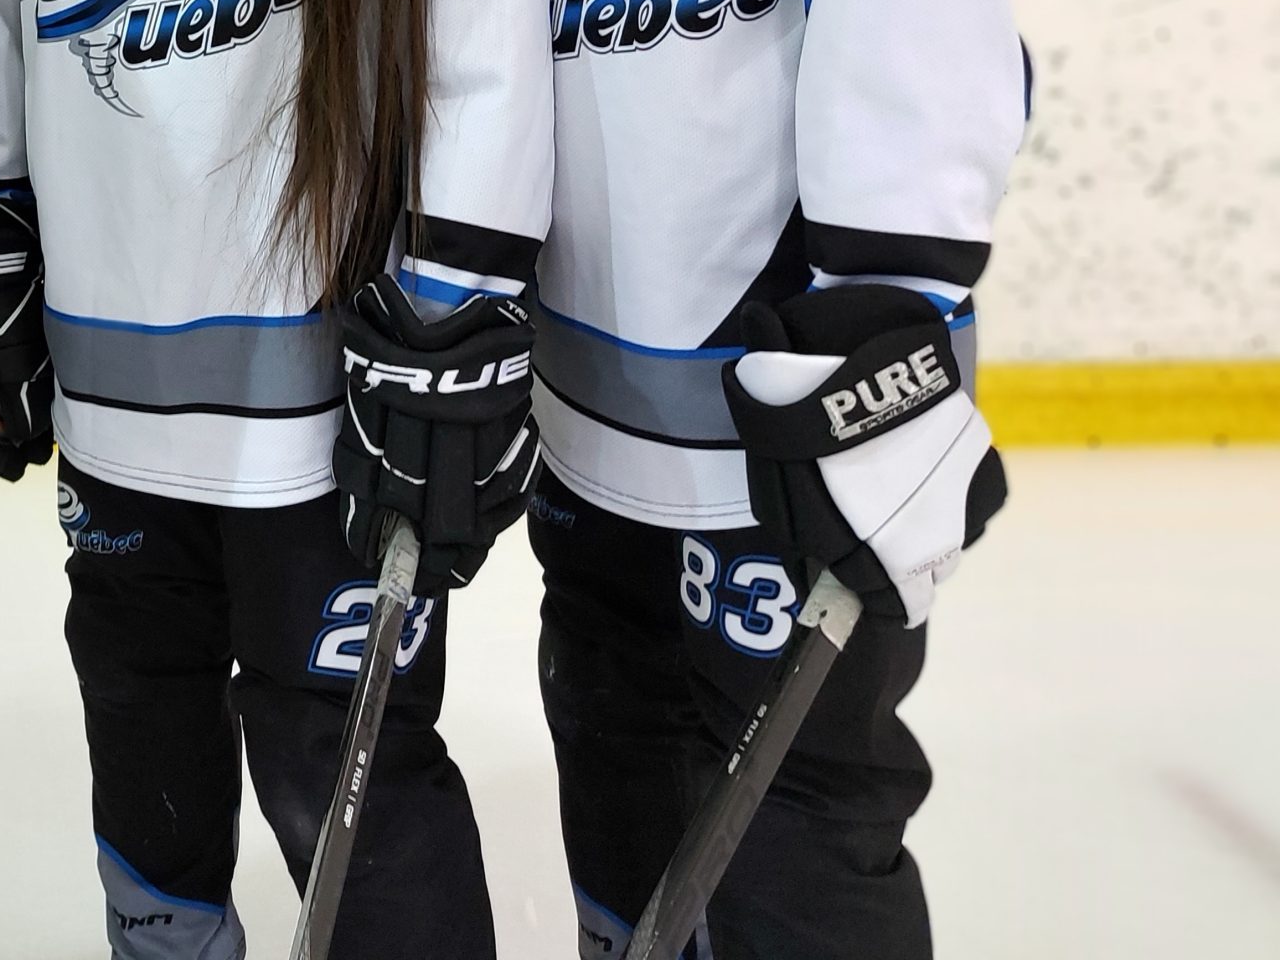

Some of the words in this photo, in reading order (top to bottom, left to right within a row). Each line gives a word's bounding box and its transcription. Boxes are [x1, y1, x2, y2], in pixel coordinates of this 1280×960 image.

[505, 299, 530, 322] TRU
[343, 345, 531, 394] TRUE
[821, 343, 945, 430] PURE
[680, 530, 801, 658] 83
[351, 767, 362, 793] FLEX
